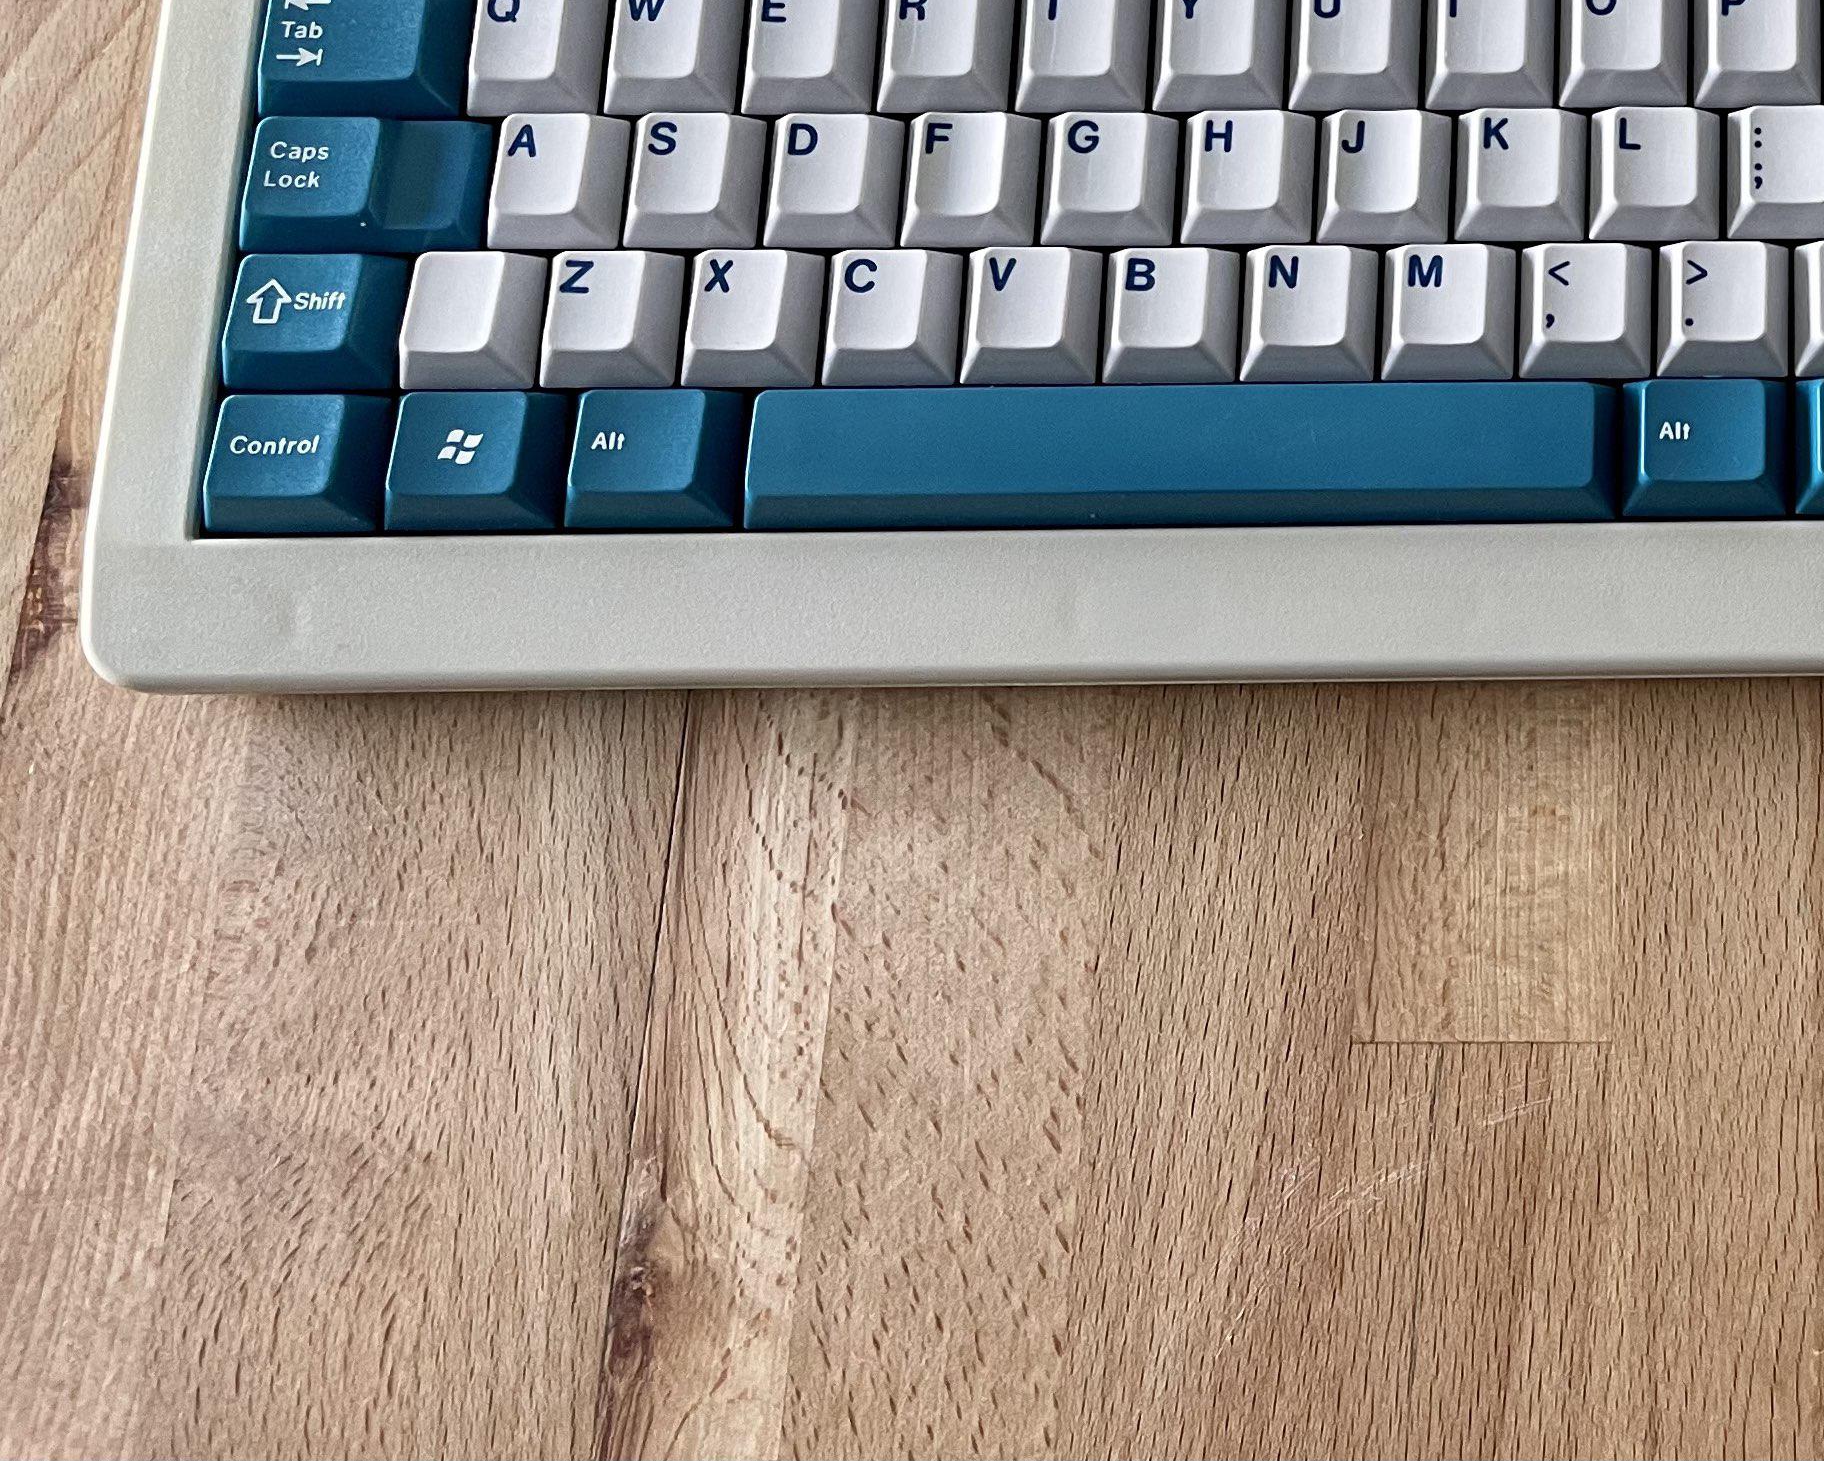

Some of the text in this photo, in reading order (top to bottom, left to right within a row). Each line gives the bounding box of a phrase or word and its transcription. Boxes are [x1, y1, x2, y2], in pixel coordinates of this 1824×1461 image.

[282, 21, 322, 38] Tab
[508, 125, 536, 157] A
[648, 122, 677, 155] S
[788, 124, 818, 155] D
[925, 123, 952, 154] F
[1068, 121, 1099, 153] G
[1205, 120, 1233, 152] H
[1342, 121, 1365, 153] J
[1484, 118, 1509, 150] K
[1619, 118, 1641, 150] L
[271, 142, 329, 162] Caps
[264, 171, 319, 187] Lock
[560, 260, 594, 293] Z
[704, 260, 733, 293] X
[845, 259, 877, 293] C
[989, 258, 1016, 291] V
[1126, 258, 1155, 291] B
[1269, 256, 1298, 289] N
[1408, 255, 1443, 287] M
[1548, 261, 1570, 286] <
[1686, 260, 1707, 285] >
[294, 292, 346, 310] Shift
[1545, 313, 1556, 329] ,
[230, 435, 319, 454] Control
[591, 432, 624, 450] Alt
[1660, 422, 1690, 439] Alt
